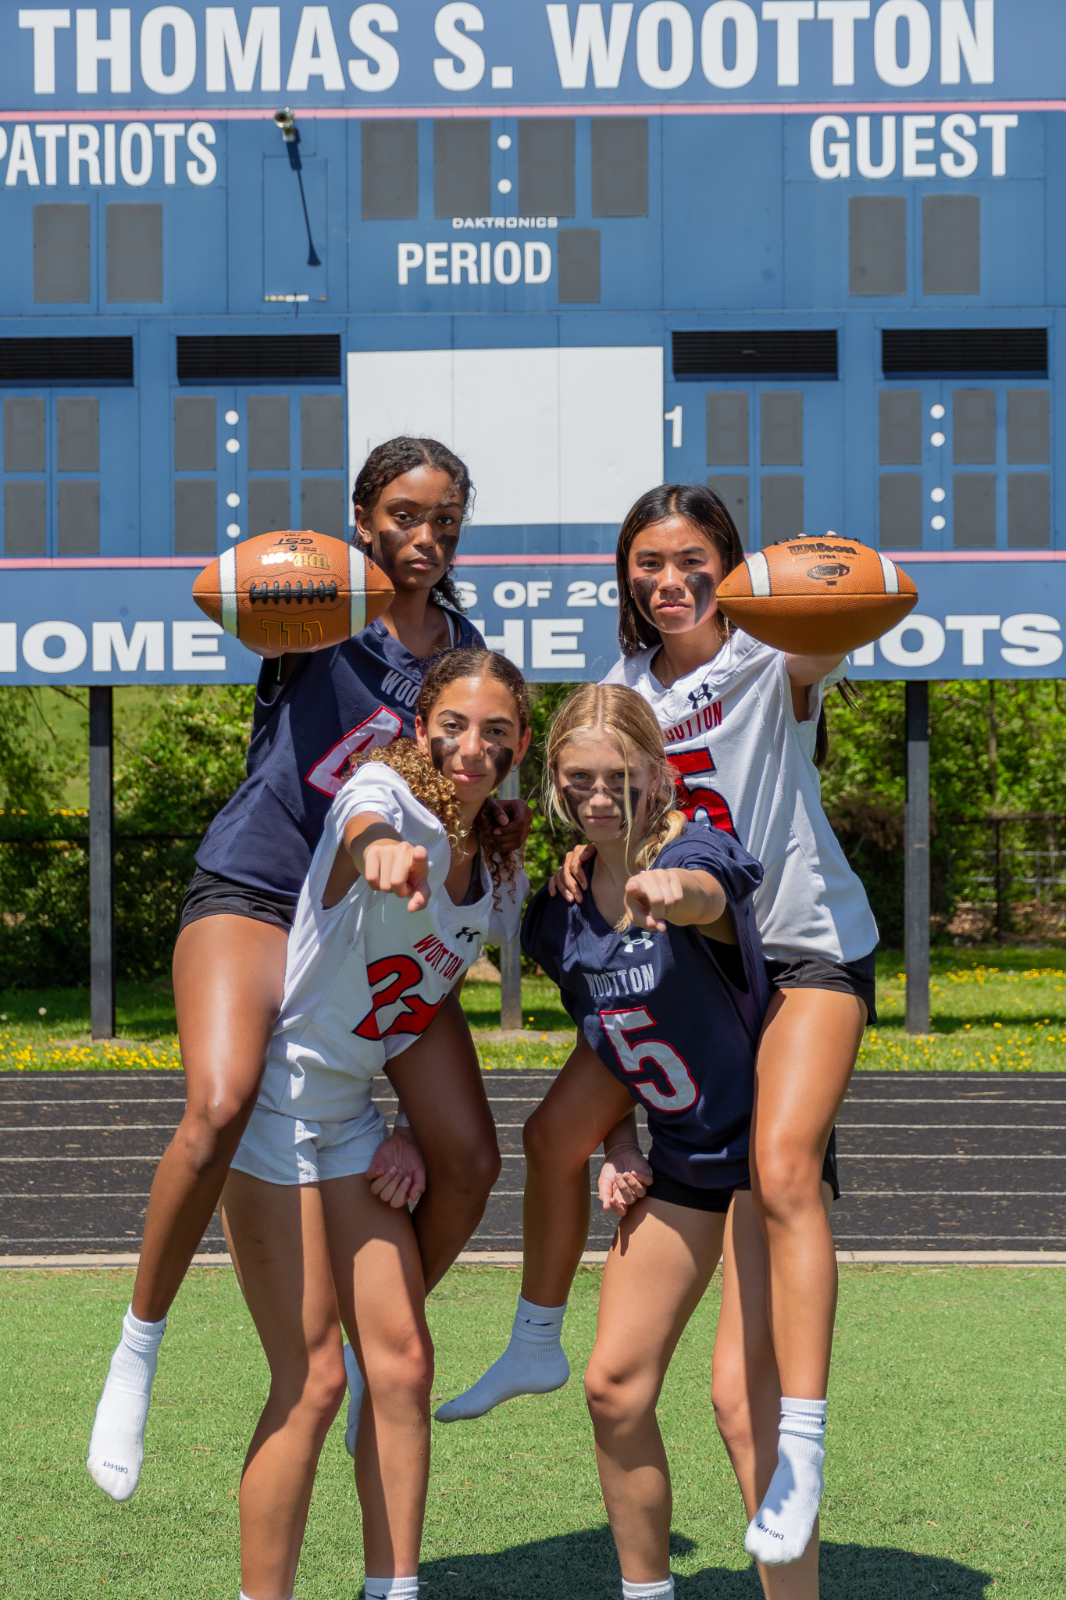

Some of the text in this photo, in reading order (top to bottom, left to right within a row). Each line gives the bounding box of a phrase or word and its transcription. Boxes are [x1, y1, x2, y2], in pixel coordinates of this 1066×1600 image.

[18, 0, 995, 95] THOMAS S. WOOTTON
[0, 121, 217, 187] ATRIOTS
[809, 113, 1019, 180] GUEST
[452, 216, 559, 230] DAKTRONICS
[397, 240, 552, 286] PERIOD
[664, 405, 683, 448] 1
[493, 581, 553, 609] OF
[599, 1005, 700, 1114] 5
